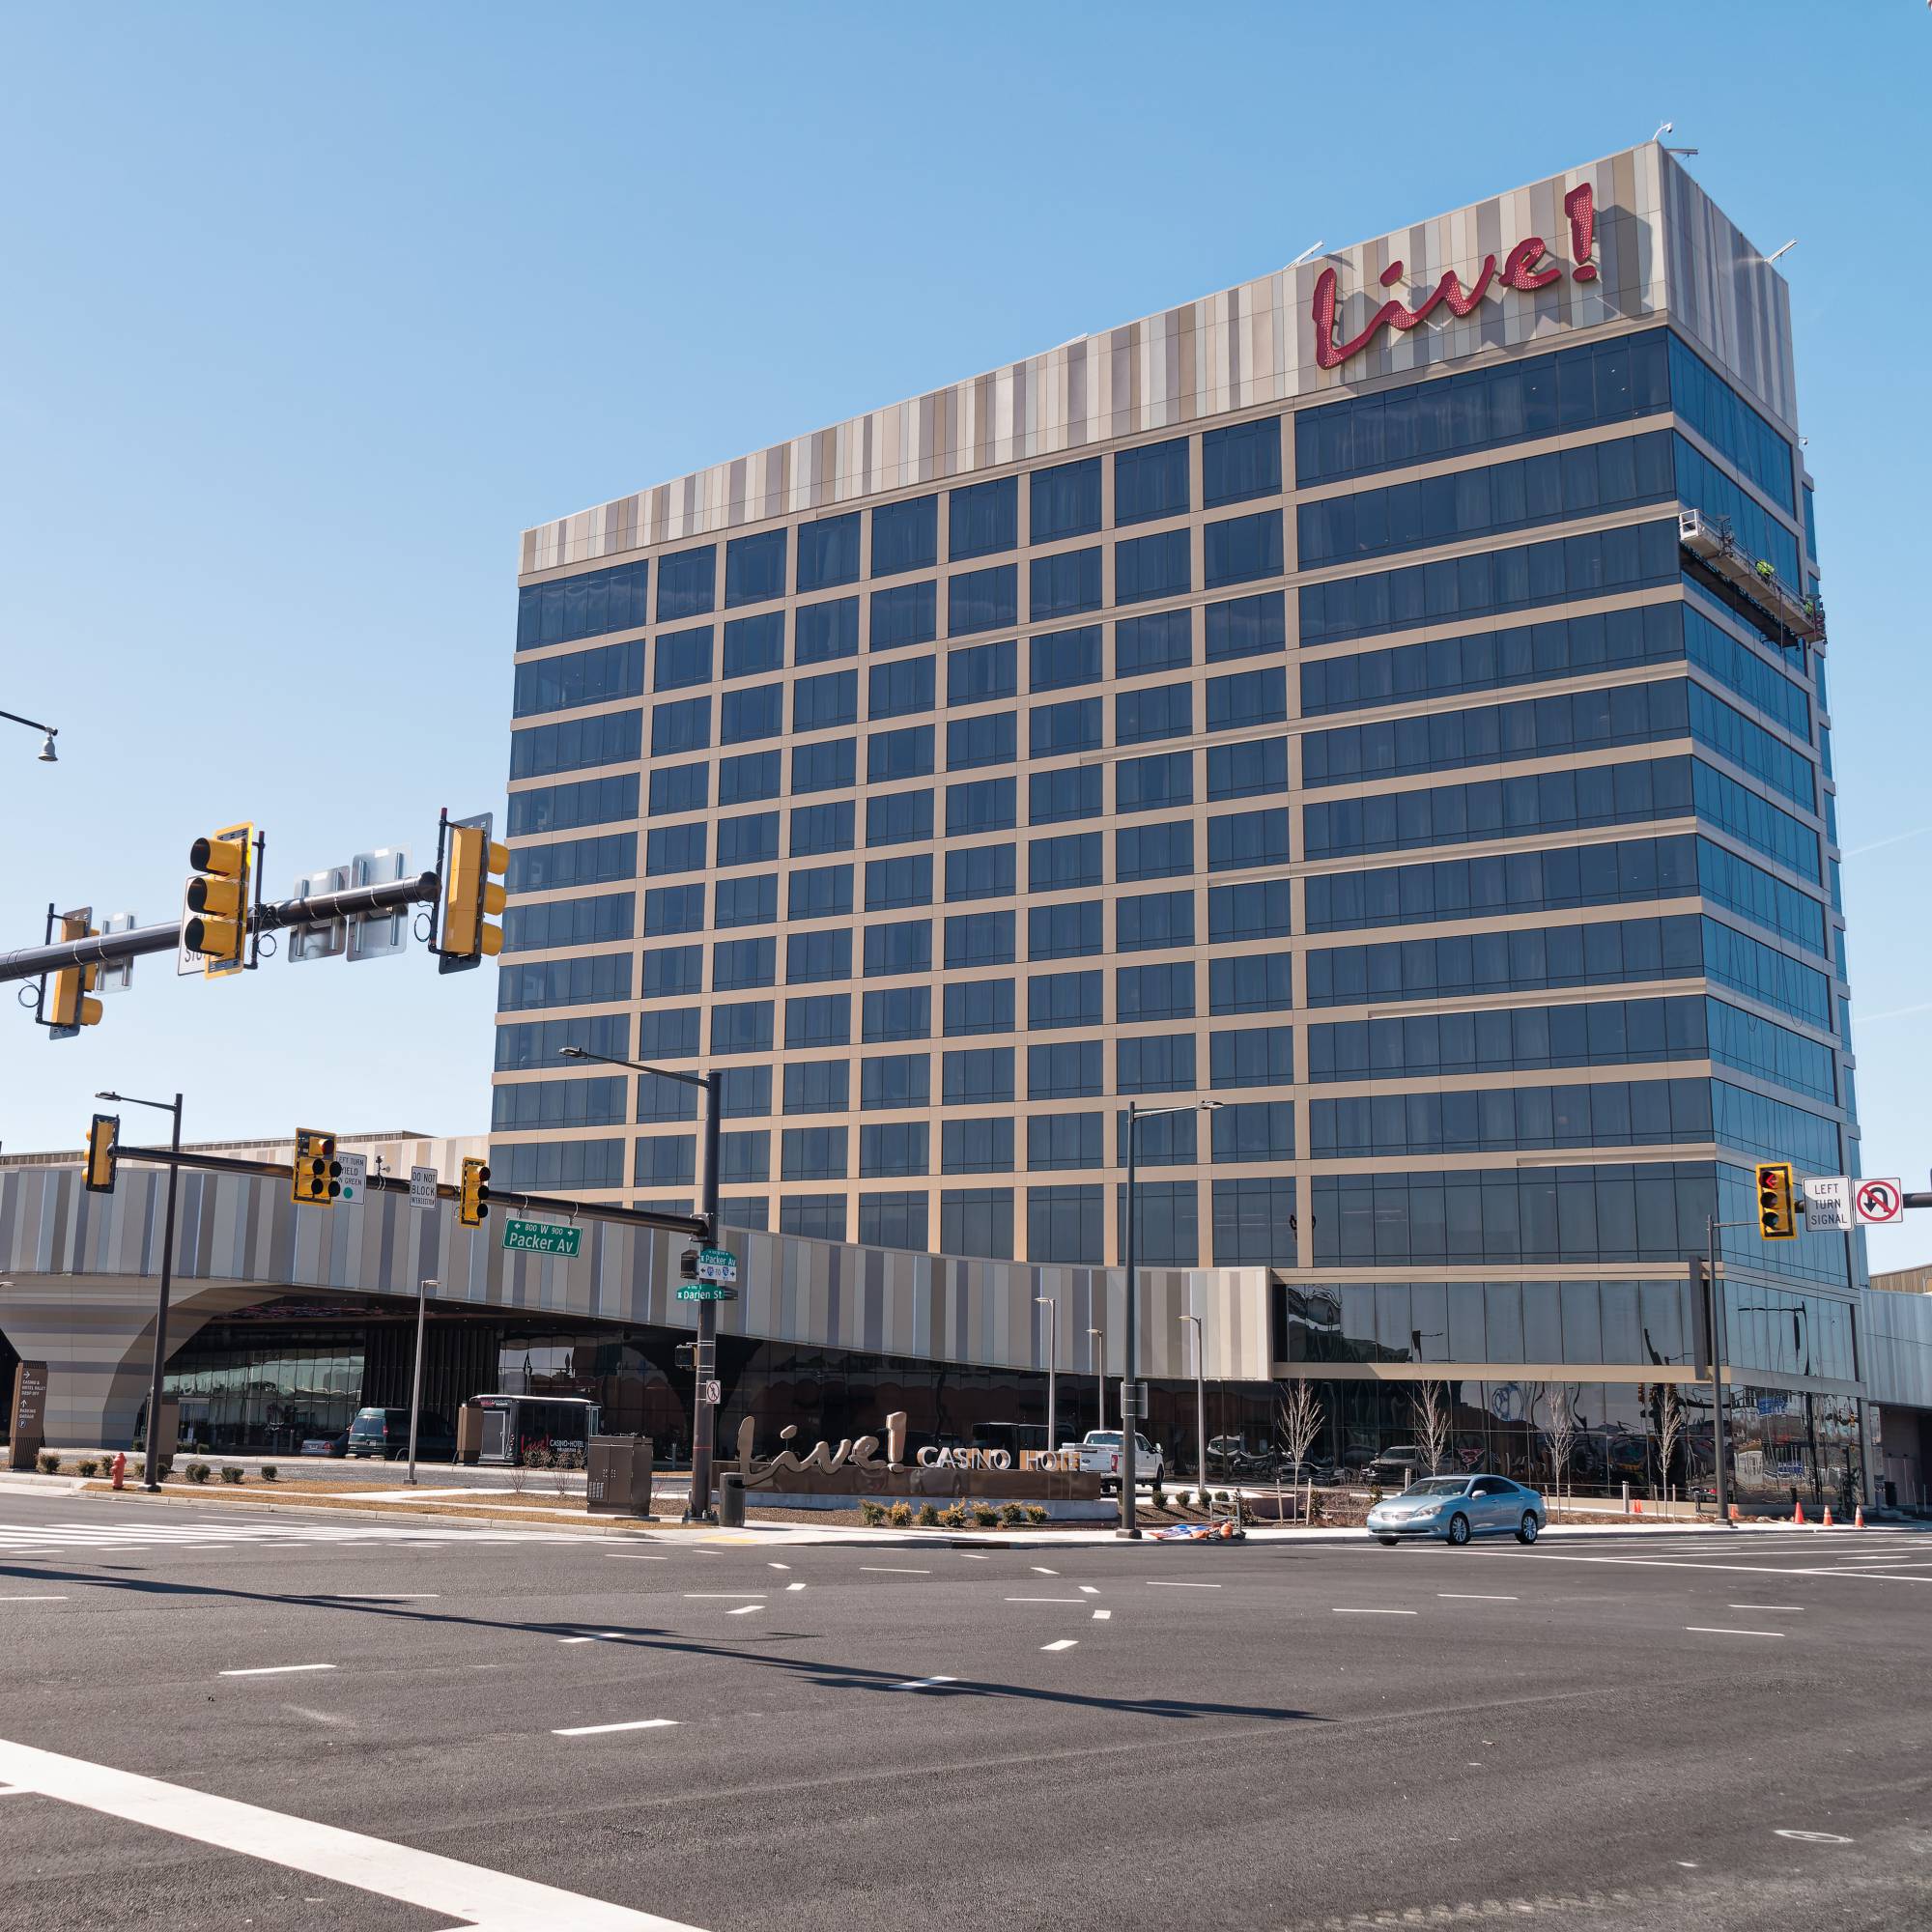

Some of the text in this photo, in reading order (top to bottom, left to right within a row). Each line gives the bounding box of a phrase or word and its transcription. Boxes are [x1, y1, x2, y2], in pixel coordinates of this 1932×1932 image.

[1312, 183, 1598, 370] Live!
[351, 1157, 364, 1167] TURN
[340, 1166, 358, 1176] YIELD
[345, 1178, 362, 1186] GREEN
[412, 1171, 437, 1184] DO NOT
[412, 1184, 435, 1197] BLOCK
[1814, 1183, 1839, 1195] LEFT
[1815, 1199, 1841, 1210] TURN
[1810, 1213, 1848, 1225] SIGNAL
[525, 1223, 538, 1232] 800
[540, 1225, 549, 1235] W
[509, 1232, 574, 1253] Packer Av
[705, 1254, 736, 1266] Packer Av
[683, 1290, 723, 1299] Darien St
[737, 1411, 907, 1488] Live!
[917, 1446, 1011, 1471] CASINO
